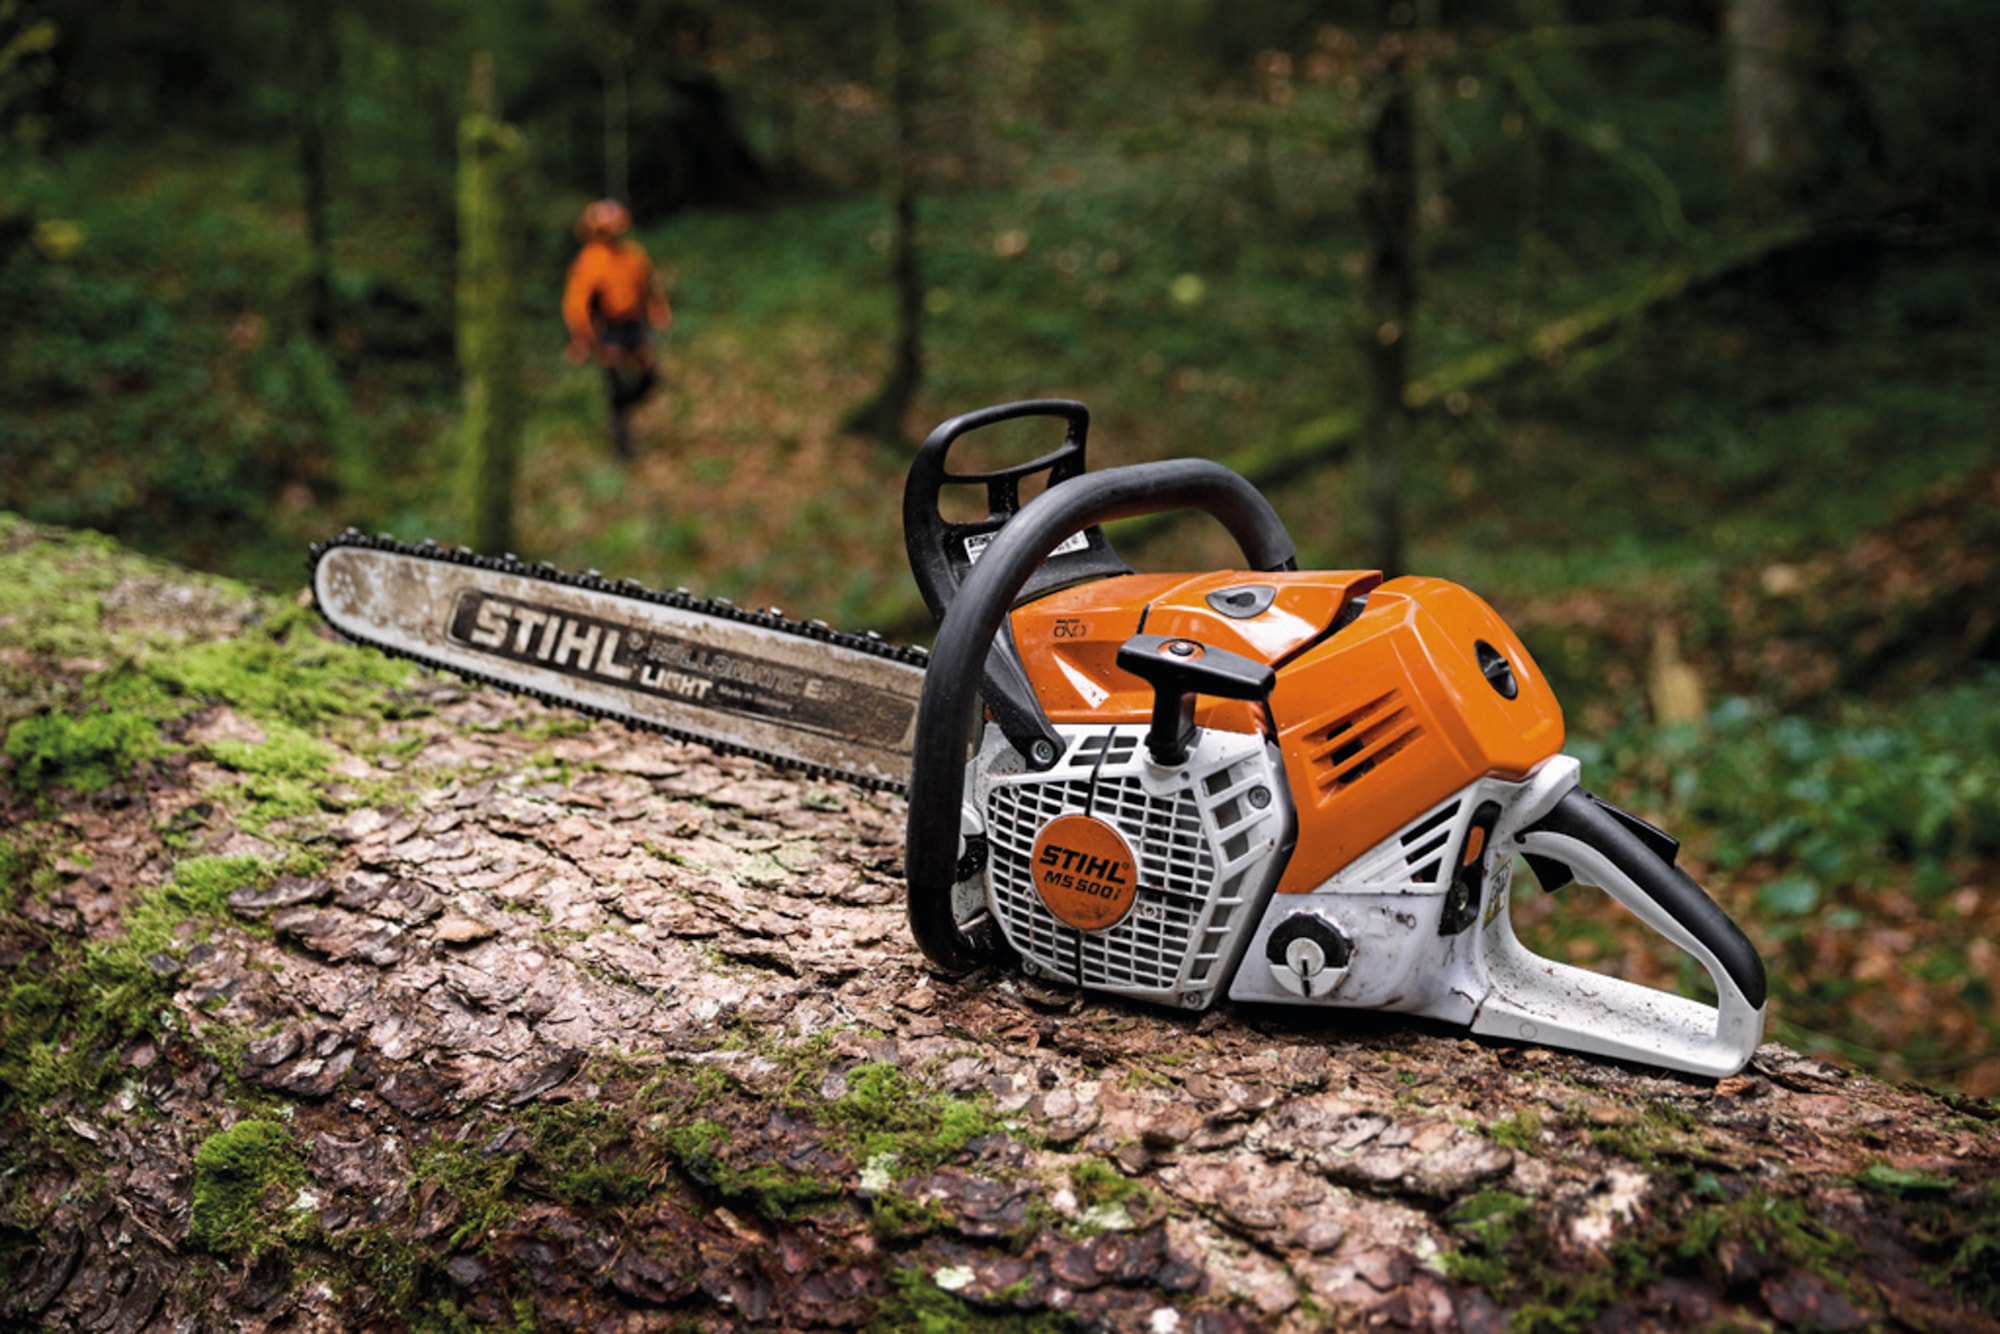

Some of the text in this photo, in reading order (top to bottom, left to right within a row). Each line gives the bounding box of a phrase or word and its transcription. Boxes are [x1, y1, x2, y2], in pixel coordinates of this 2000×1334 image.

[471, 600, 632, 680] STIHL
[1039, 844, 1126, 884] STIHL
[1044, 871, 1074, 889] MS
